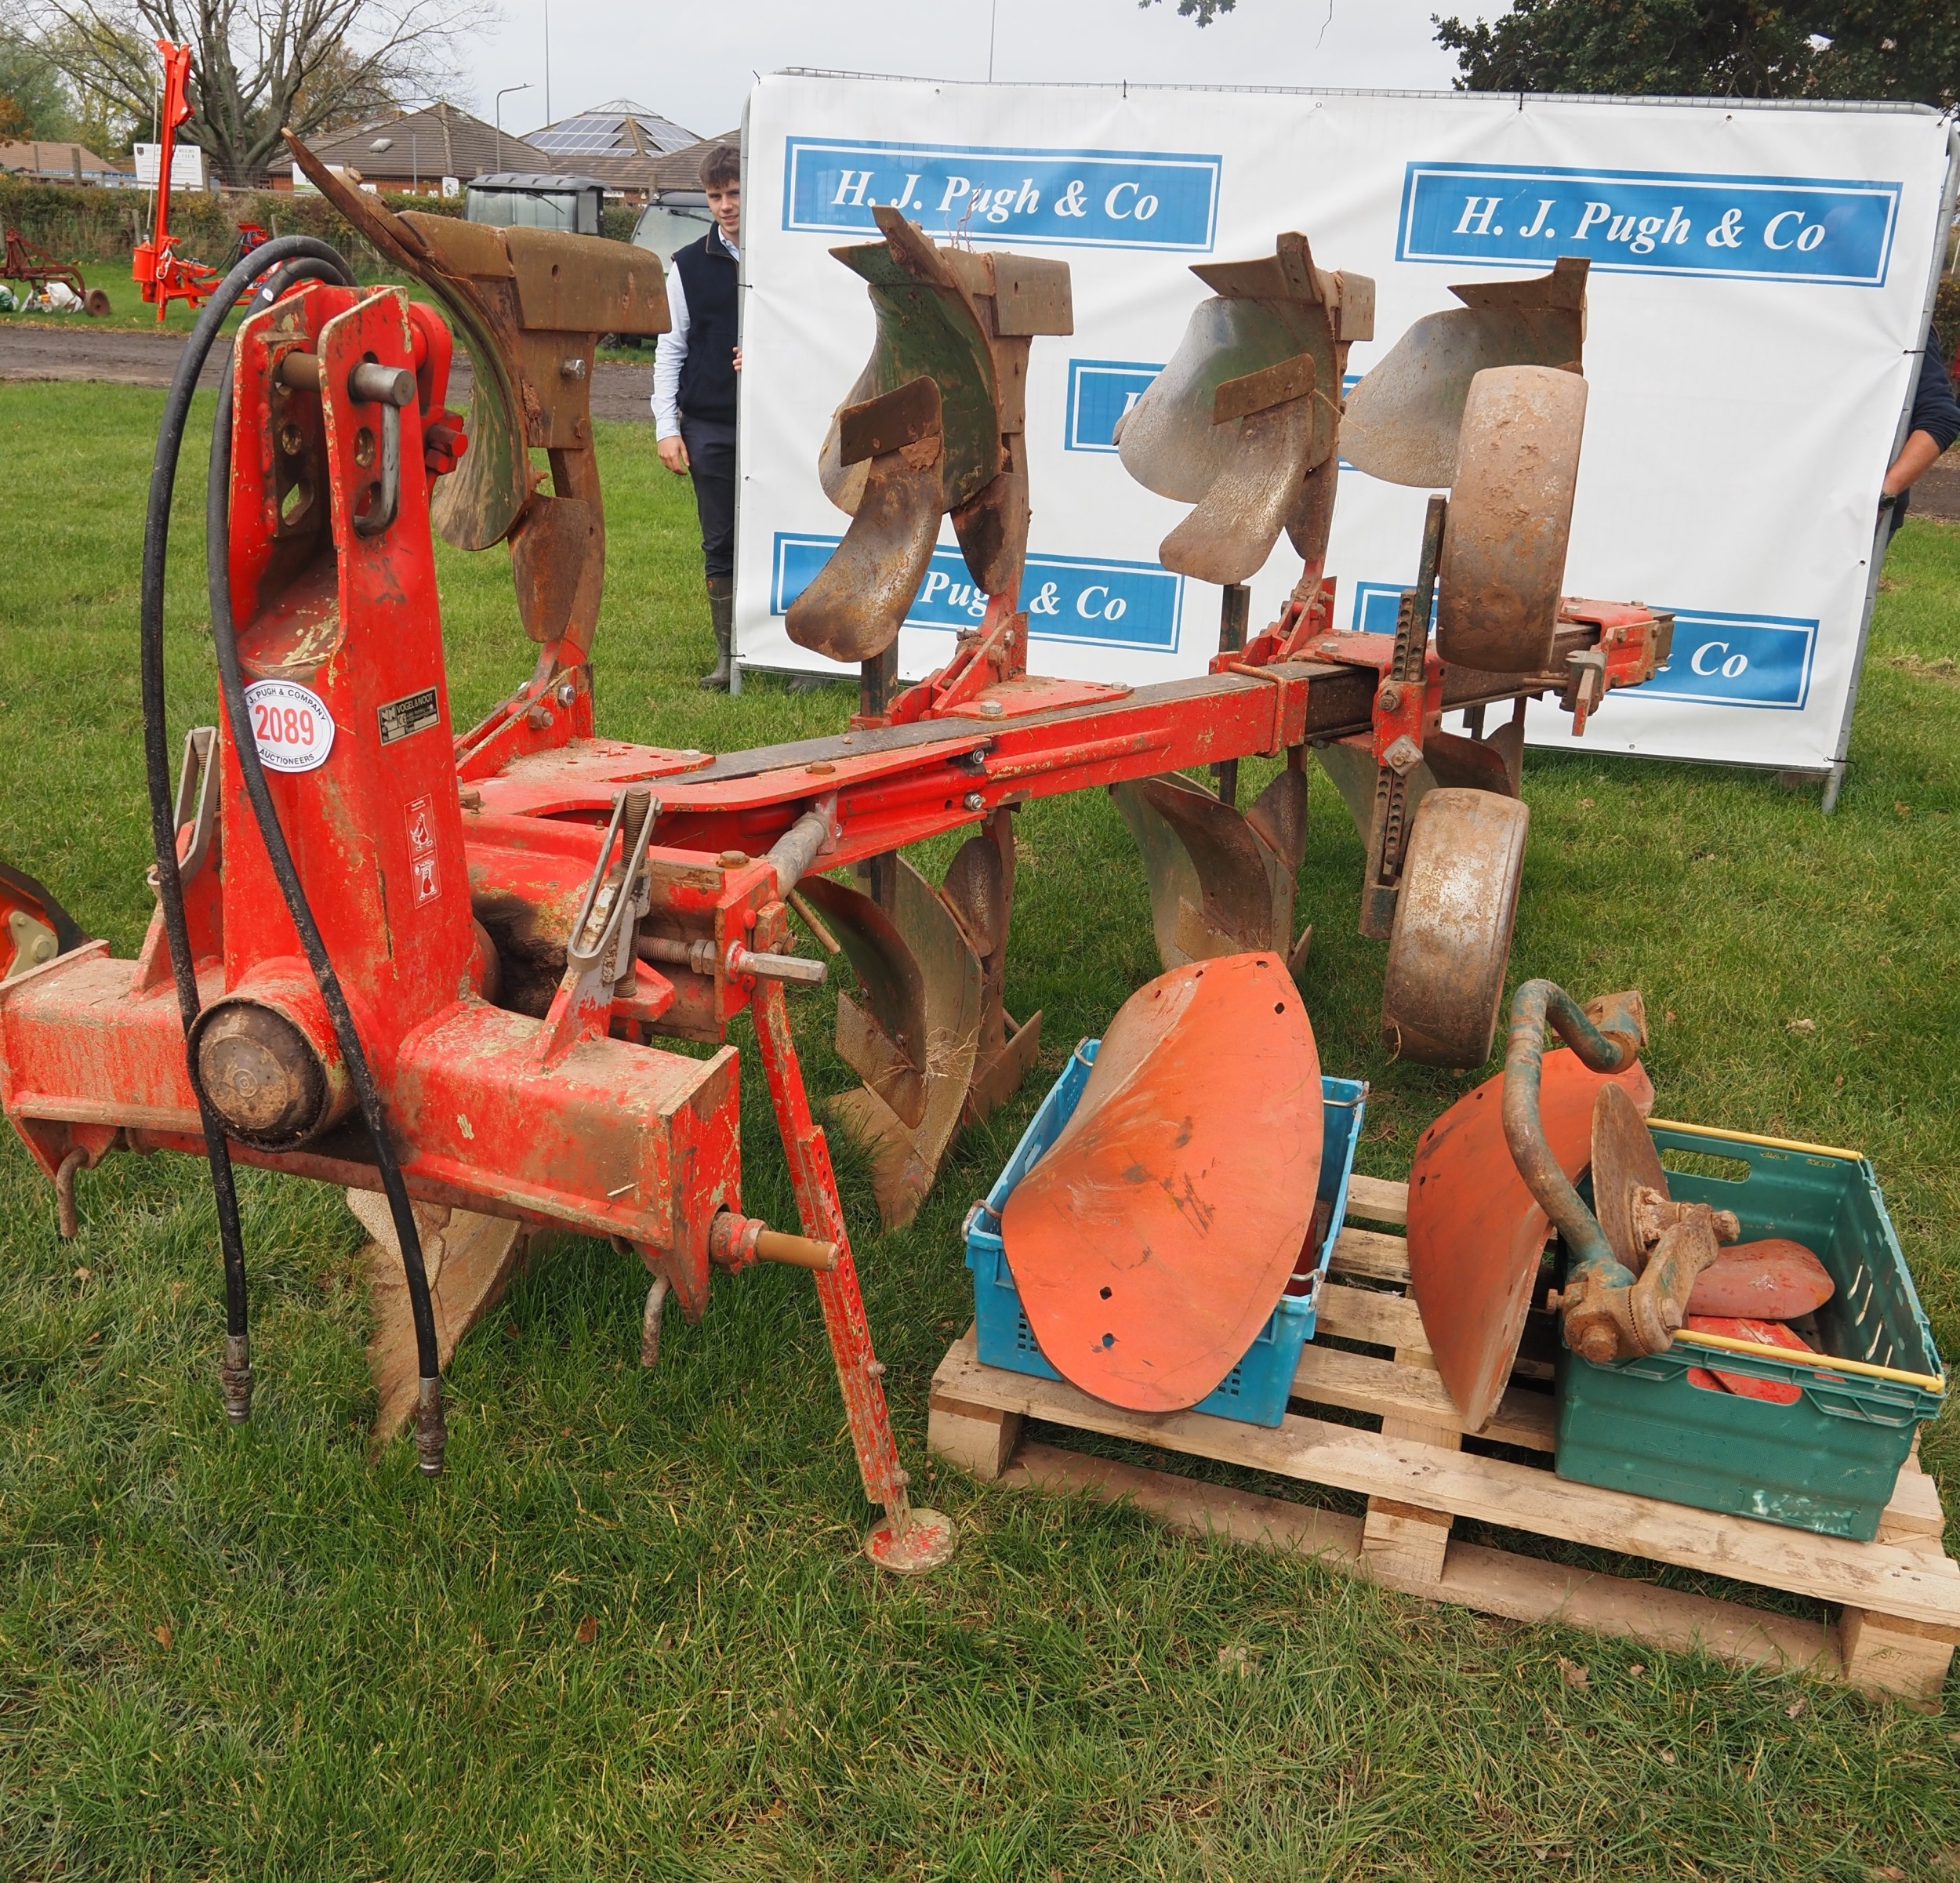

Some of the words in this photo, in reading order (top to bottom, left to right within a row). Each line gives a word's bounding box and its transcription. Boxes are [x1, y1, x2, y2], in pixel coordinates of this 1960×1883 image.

[830, 169, 877, 208] H.
[890, 174, 924, 211] J.
[935, 176, 1040, 223] Pugh
[1054, 180, 1088, 217] &
[1105, 182, 1160, 221] Co
[1452, 196, 1504, 236] H.
[1519, 199, 1555, 238] J.
[1570, 201, 1691, 254] Pugh
[1705, 208, 1745, 249] &
[1763, 210, 1826, 251] Co
[917, 571, 990, 618] Pug
[1029, 581, 1061, 615] &
[1076, 586, 1127, 621] Co
[1691, 641, 1748, 679] Co
[255, 704, 314, 746] 2089
[256, 687, 277, 699] PUGH
[278, 688, 285, 696] &
[287, 688, 327, 721] COMPANY
[259, 748, 315, 765] AUCTIONEERS
